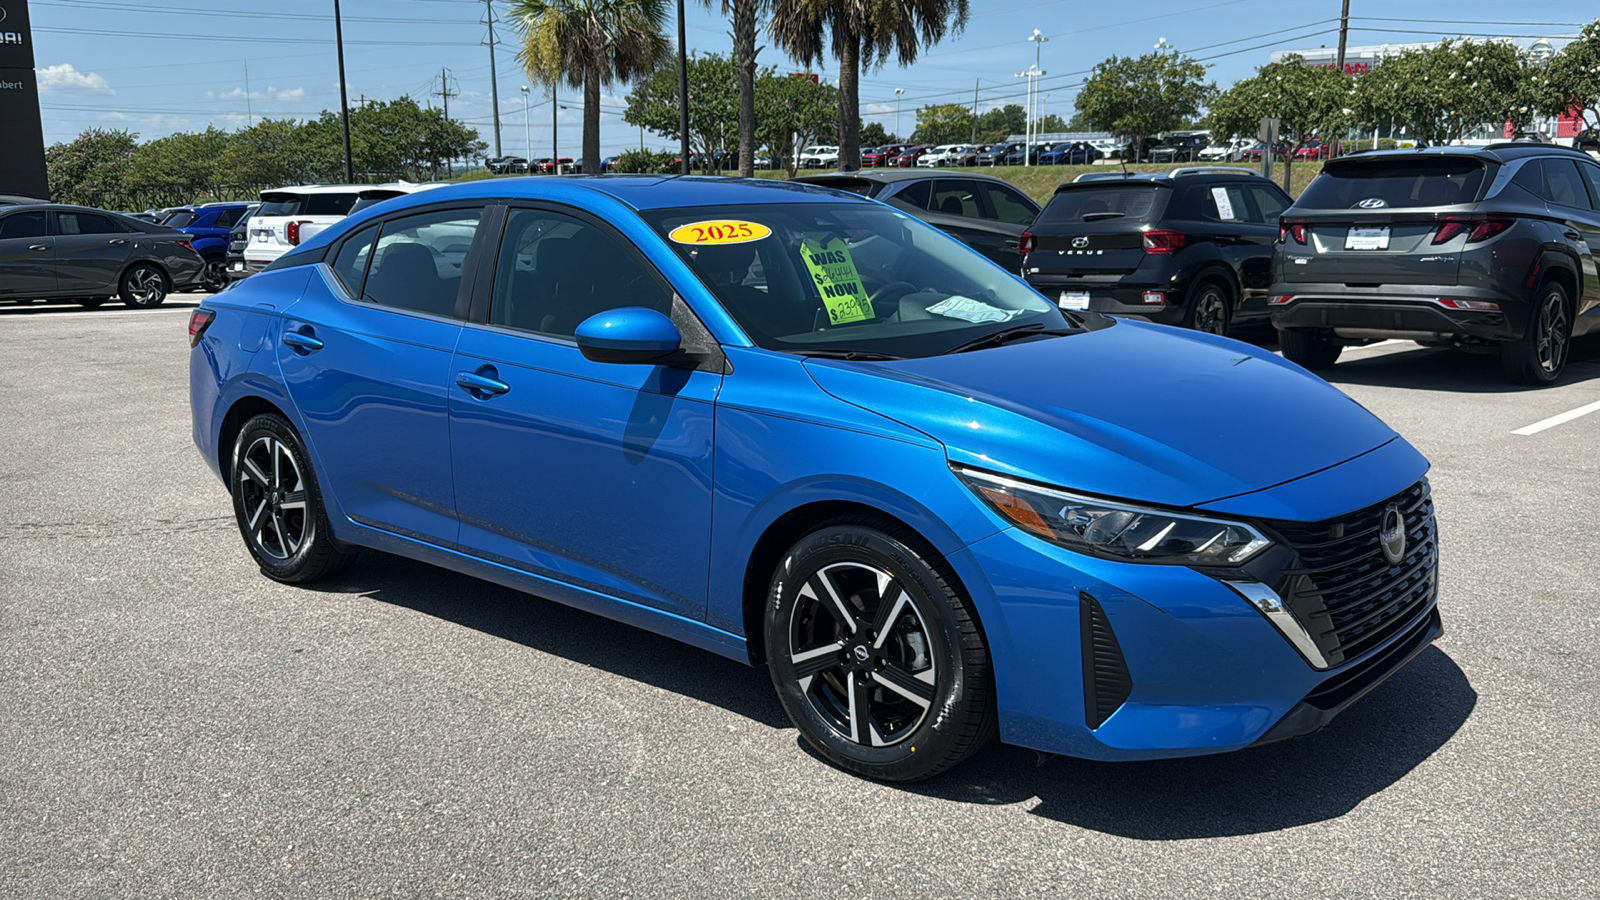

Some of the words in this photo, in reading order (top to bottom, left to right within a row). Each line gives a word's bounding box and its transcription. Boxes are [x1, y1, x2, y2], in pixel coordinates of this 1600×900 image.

[0, 80, 23, 90] bert
[691, 223, 753, 242] 2025
[808, 250, 847, 267] WAS
[822, 282, 859, 299] NOW
